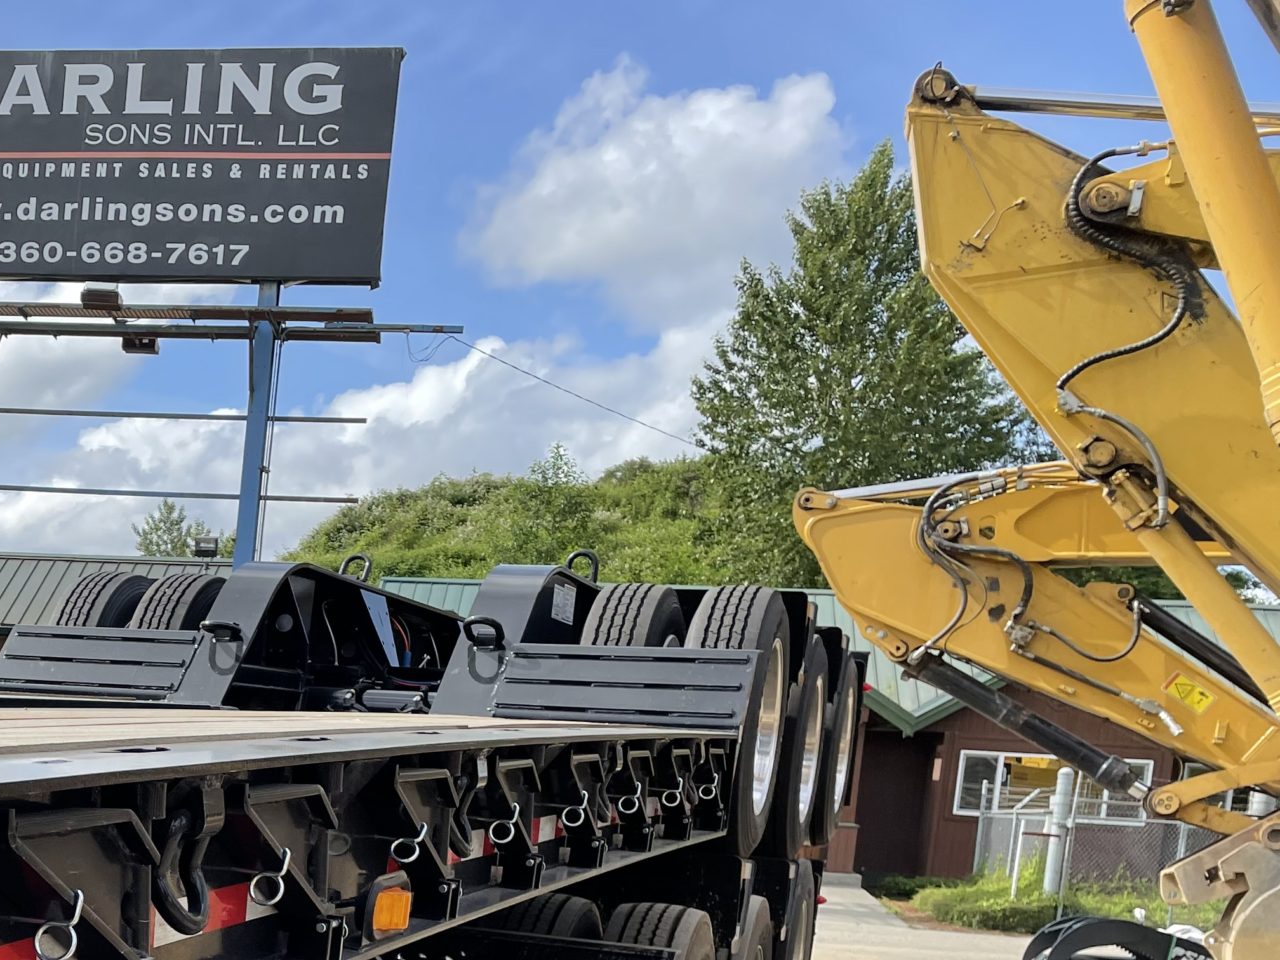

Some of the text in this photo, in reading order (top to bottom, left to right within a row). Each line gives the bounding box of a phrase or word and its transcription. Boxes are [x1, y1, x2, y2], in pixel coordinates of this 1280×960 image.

[84, 123, 340, 146] SONS INTL. LLC
[138, 162, 213, 178] SALES
[229, 163, 242, 179] &
[259, 163, 369, 179] RENTALS
